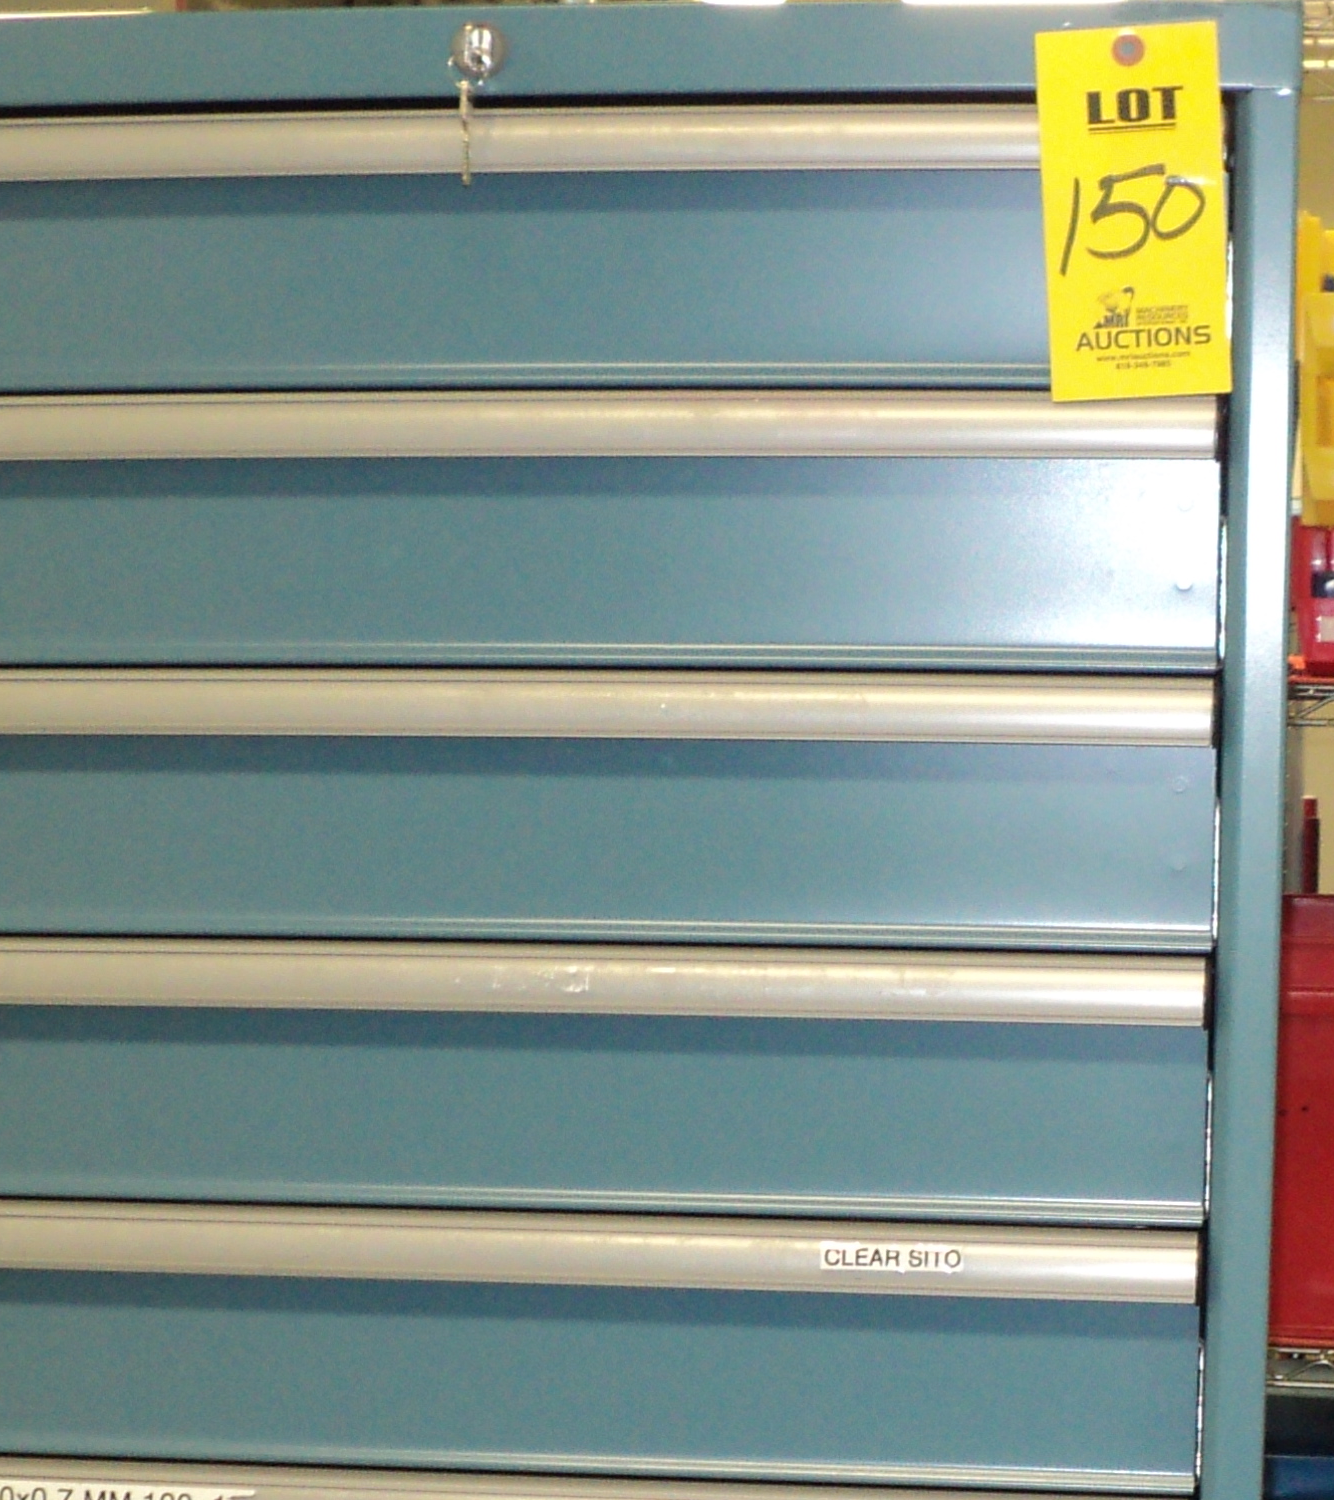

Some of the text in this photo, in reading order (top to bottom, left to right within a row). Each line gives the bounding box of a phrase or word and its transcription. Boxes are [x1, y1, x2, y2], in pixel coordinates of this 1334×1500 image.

[1085, 85, 1184, 125] LOT
[1059, 162, 1207, 277] 150
[1075, 324, 1212, 352] AUCTIONS
[823, 1247, 900, 1268] CLEAR
